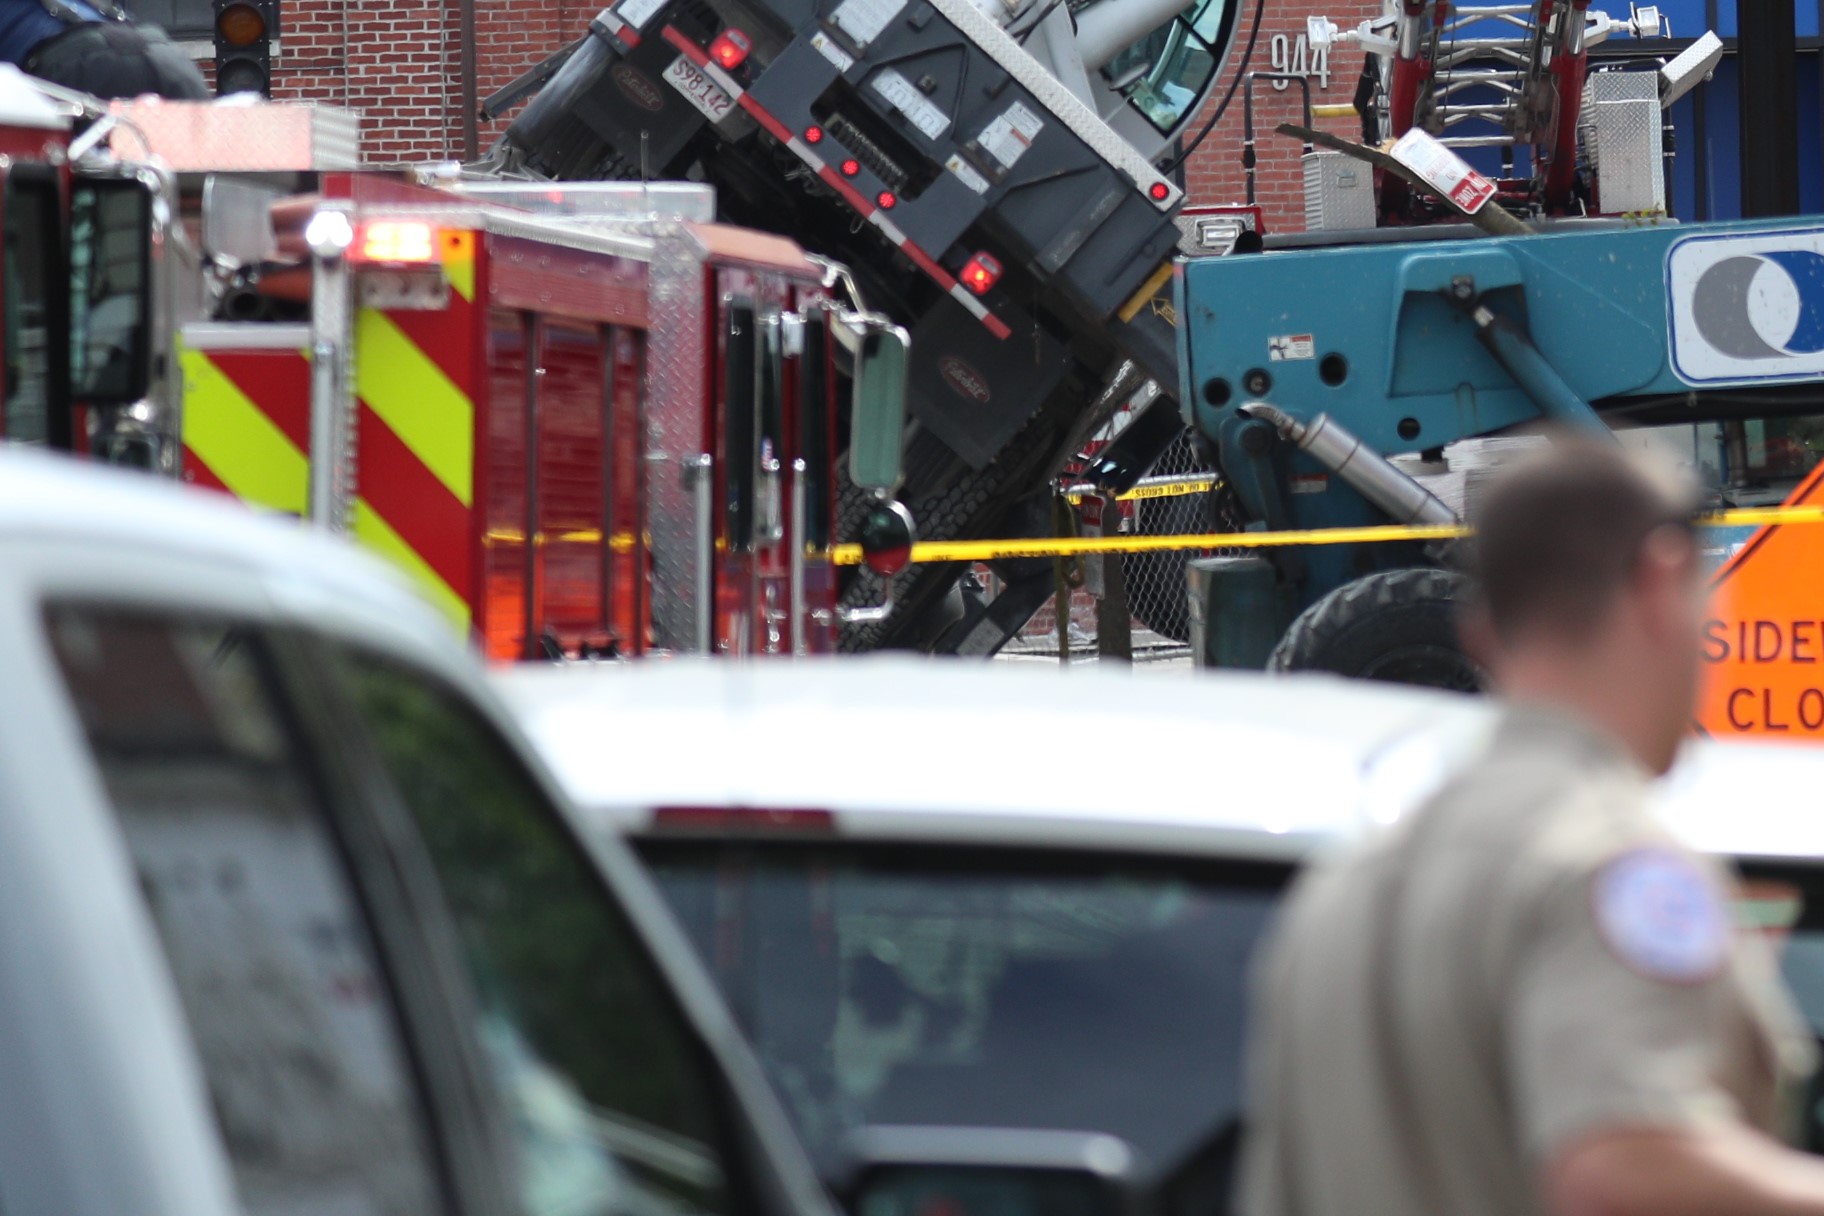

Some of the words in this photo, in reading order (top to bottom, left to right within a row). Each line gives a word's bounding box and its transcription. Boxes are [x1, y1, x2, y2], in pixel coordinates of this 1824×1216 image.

[1271, 33, 1331, 90] 944
[1455, 184, 1479, 207] ZONE
[1135, 485, 1164, 496] CROSS
